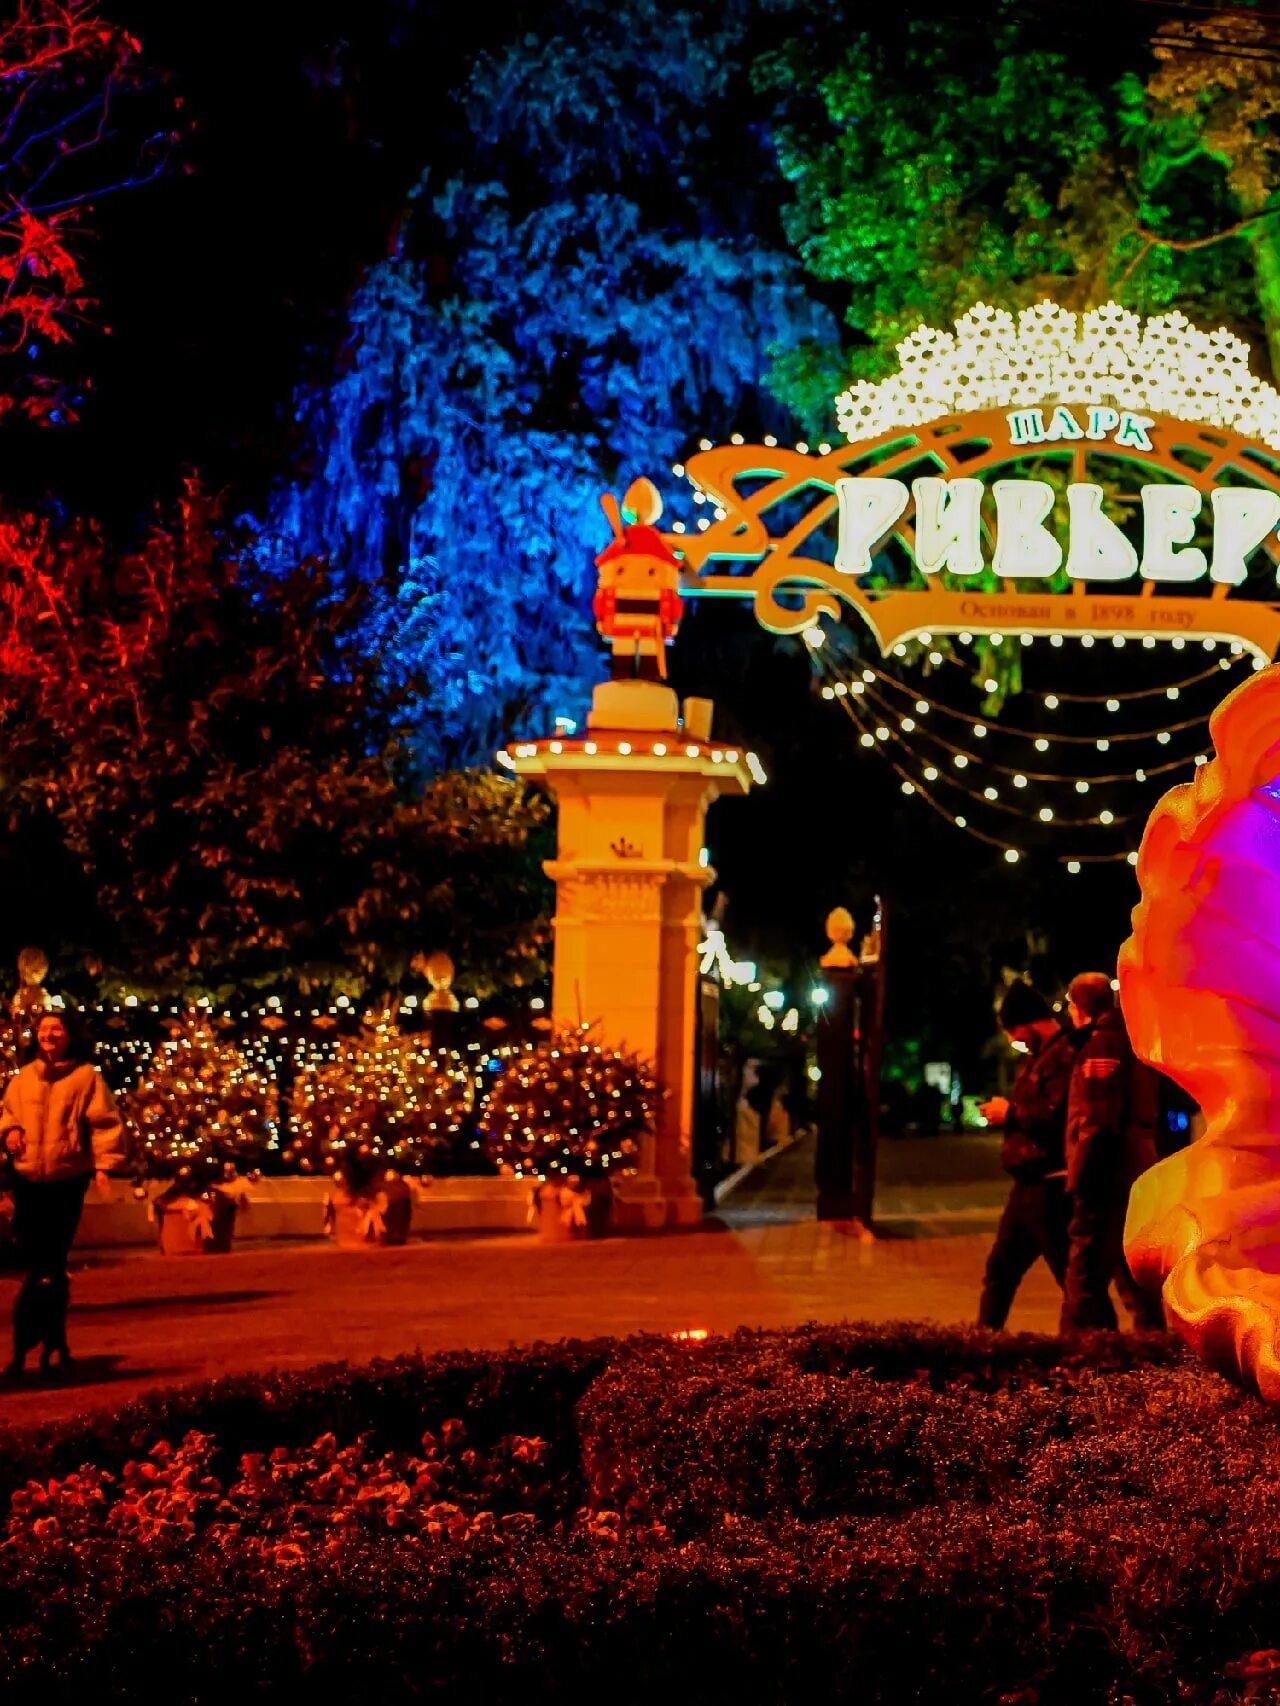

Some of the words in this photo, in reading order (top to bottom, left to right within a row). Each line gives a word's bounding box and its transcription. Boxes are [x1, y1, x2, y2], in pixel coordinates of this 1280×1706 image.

[1006, 406, 1155, 452] ПАРК
[960, 601, 1050, 619] Основан
[1065, 608, 1077, 620] в
[1092, 604, 1135, 622] 1898
[1150, 609, 1197, 628] году
